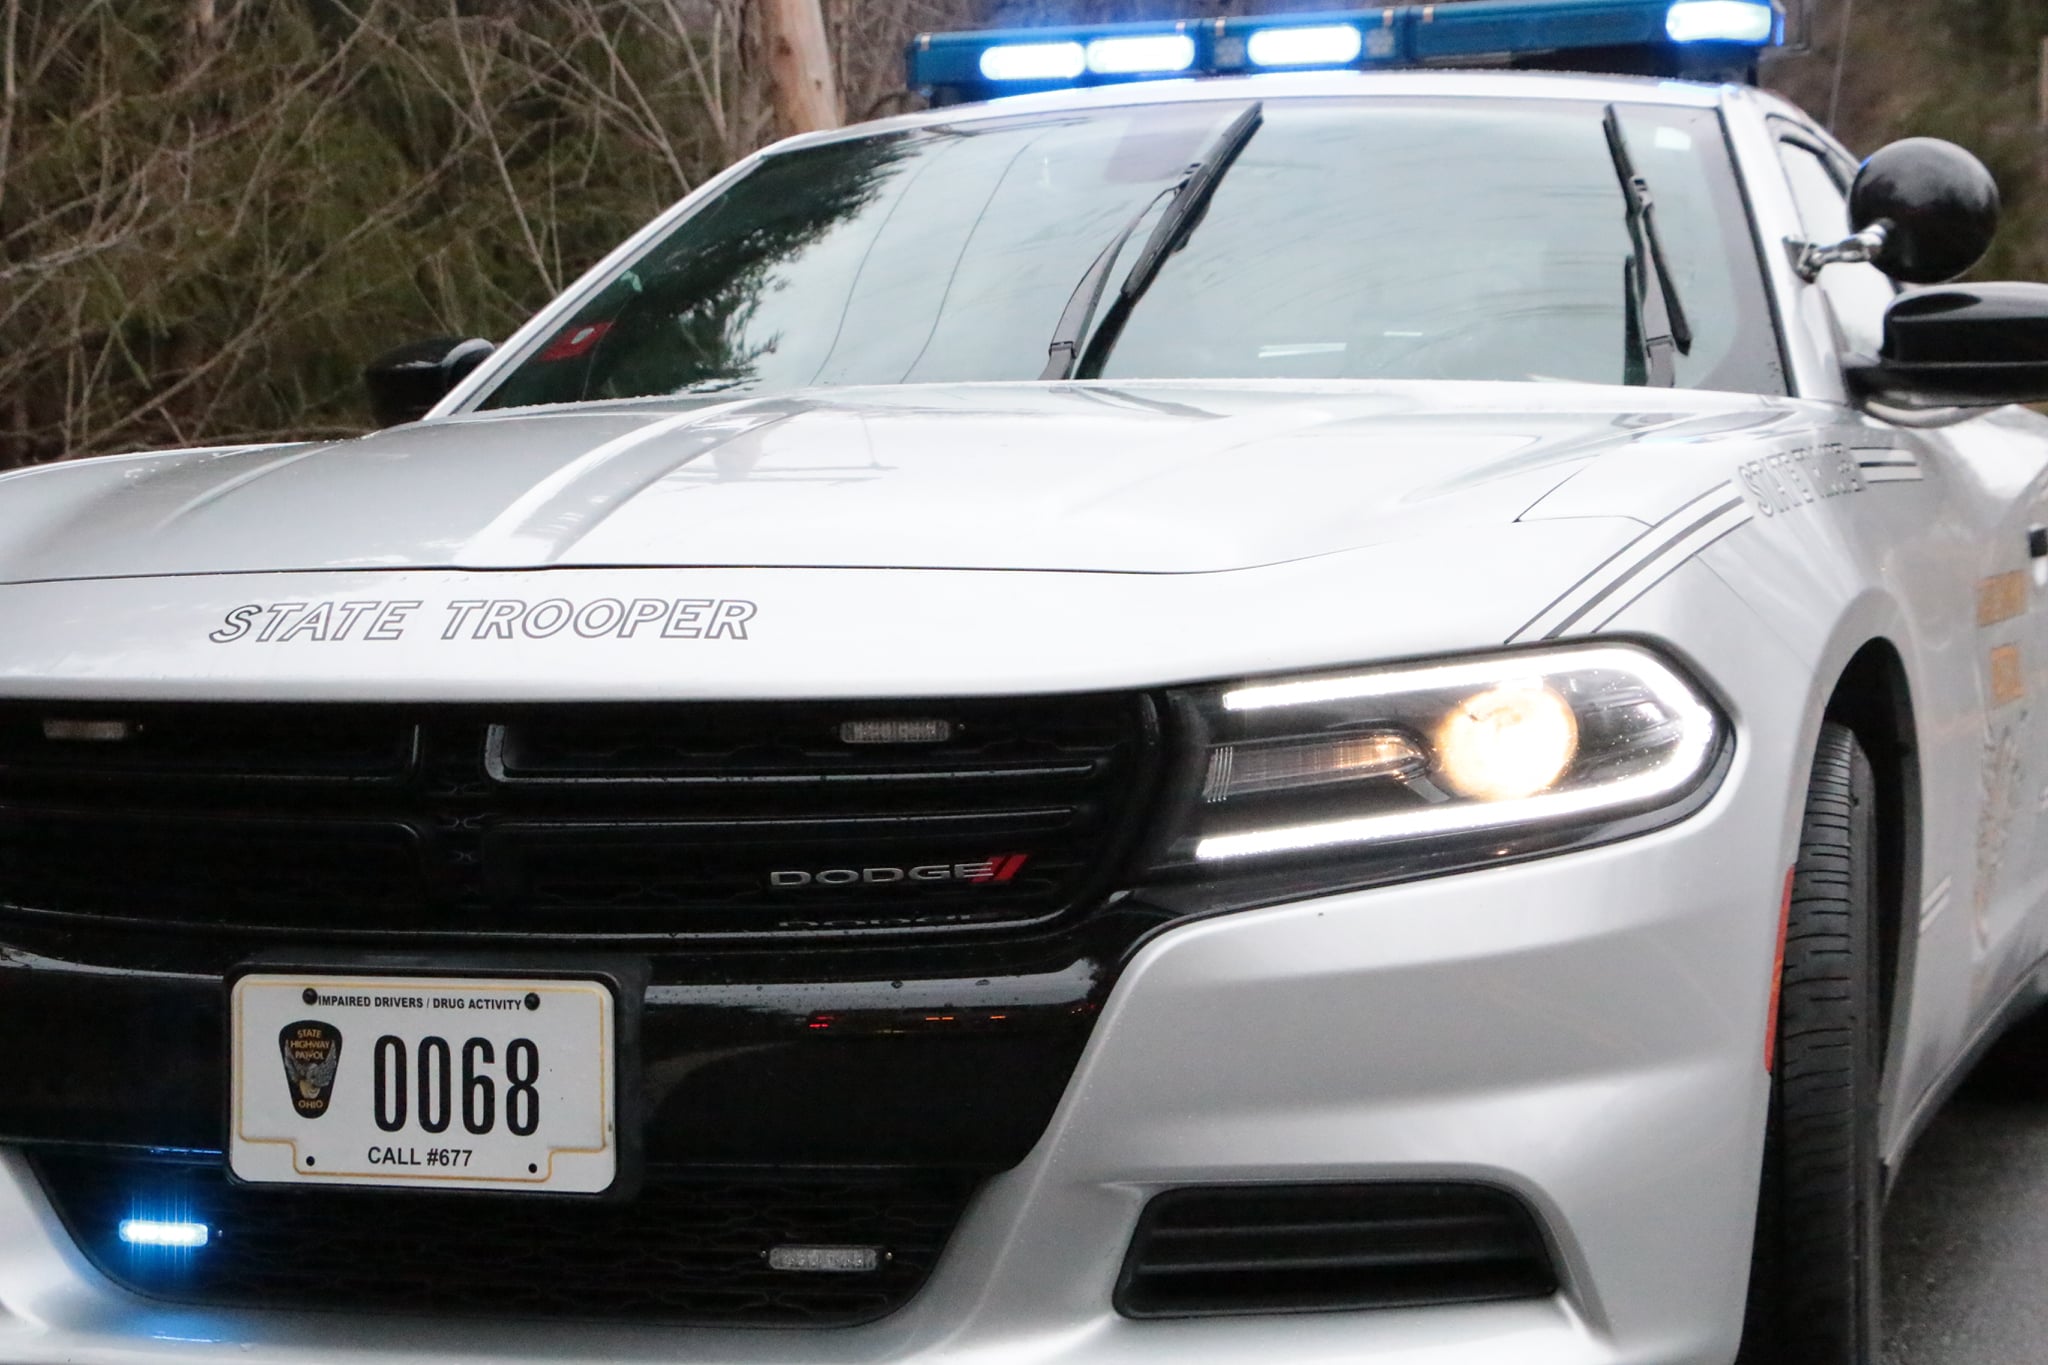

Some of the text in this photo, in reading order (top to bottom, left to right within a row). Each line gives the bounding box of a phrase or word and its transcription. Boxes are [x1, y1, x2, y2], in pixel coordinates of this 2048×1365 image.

[209, 598, 758, 643] STATE TROOPER
[770, 862, 994, 886] DODGE
[317, 995, 371, 1008] IMPAIRED
[374, 996, 423, 1009] DRIVERS
[433, 997, 465, 1010] DRUG
[468, 998, 522, 1011] ACTIVITY
[297, 1028, 322, 1039] STATE
[290, 1039, 331, 1049] HIGHWAY
[373, 1034, 540, 1136] 0068
[298, 1099, 323, 1109] OHIO
[367, 1146, 473, 1167] CALL #677
